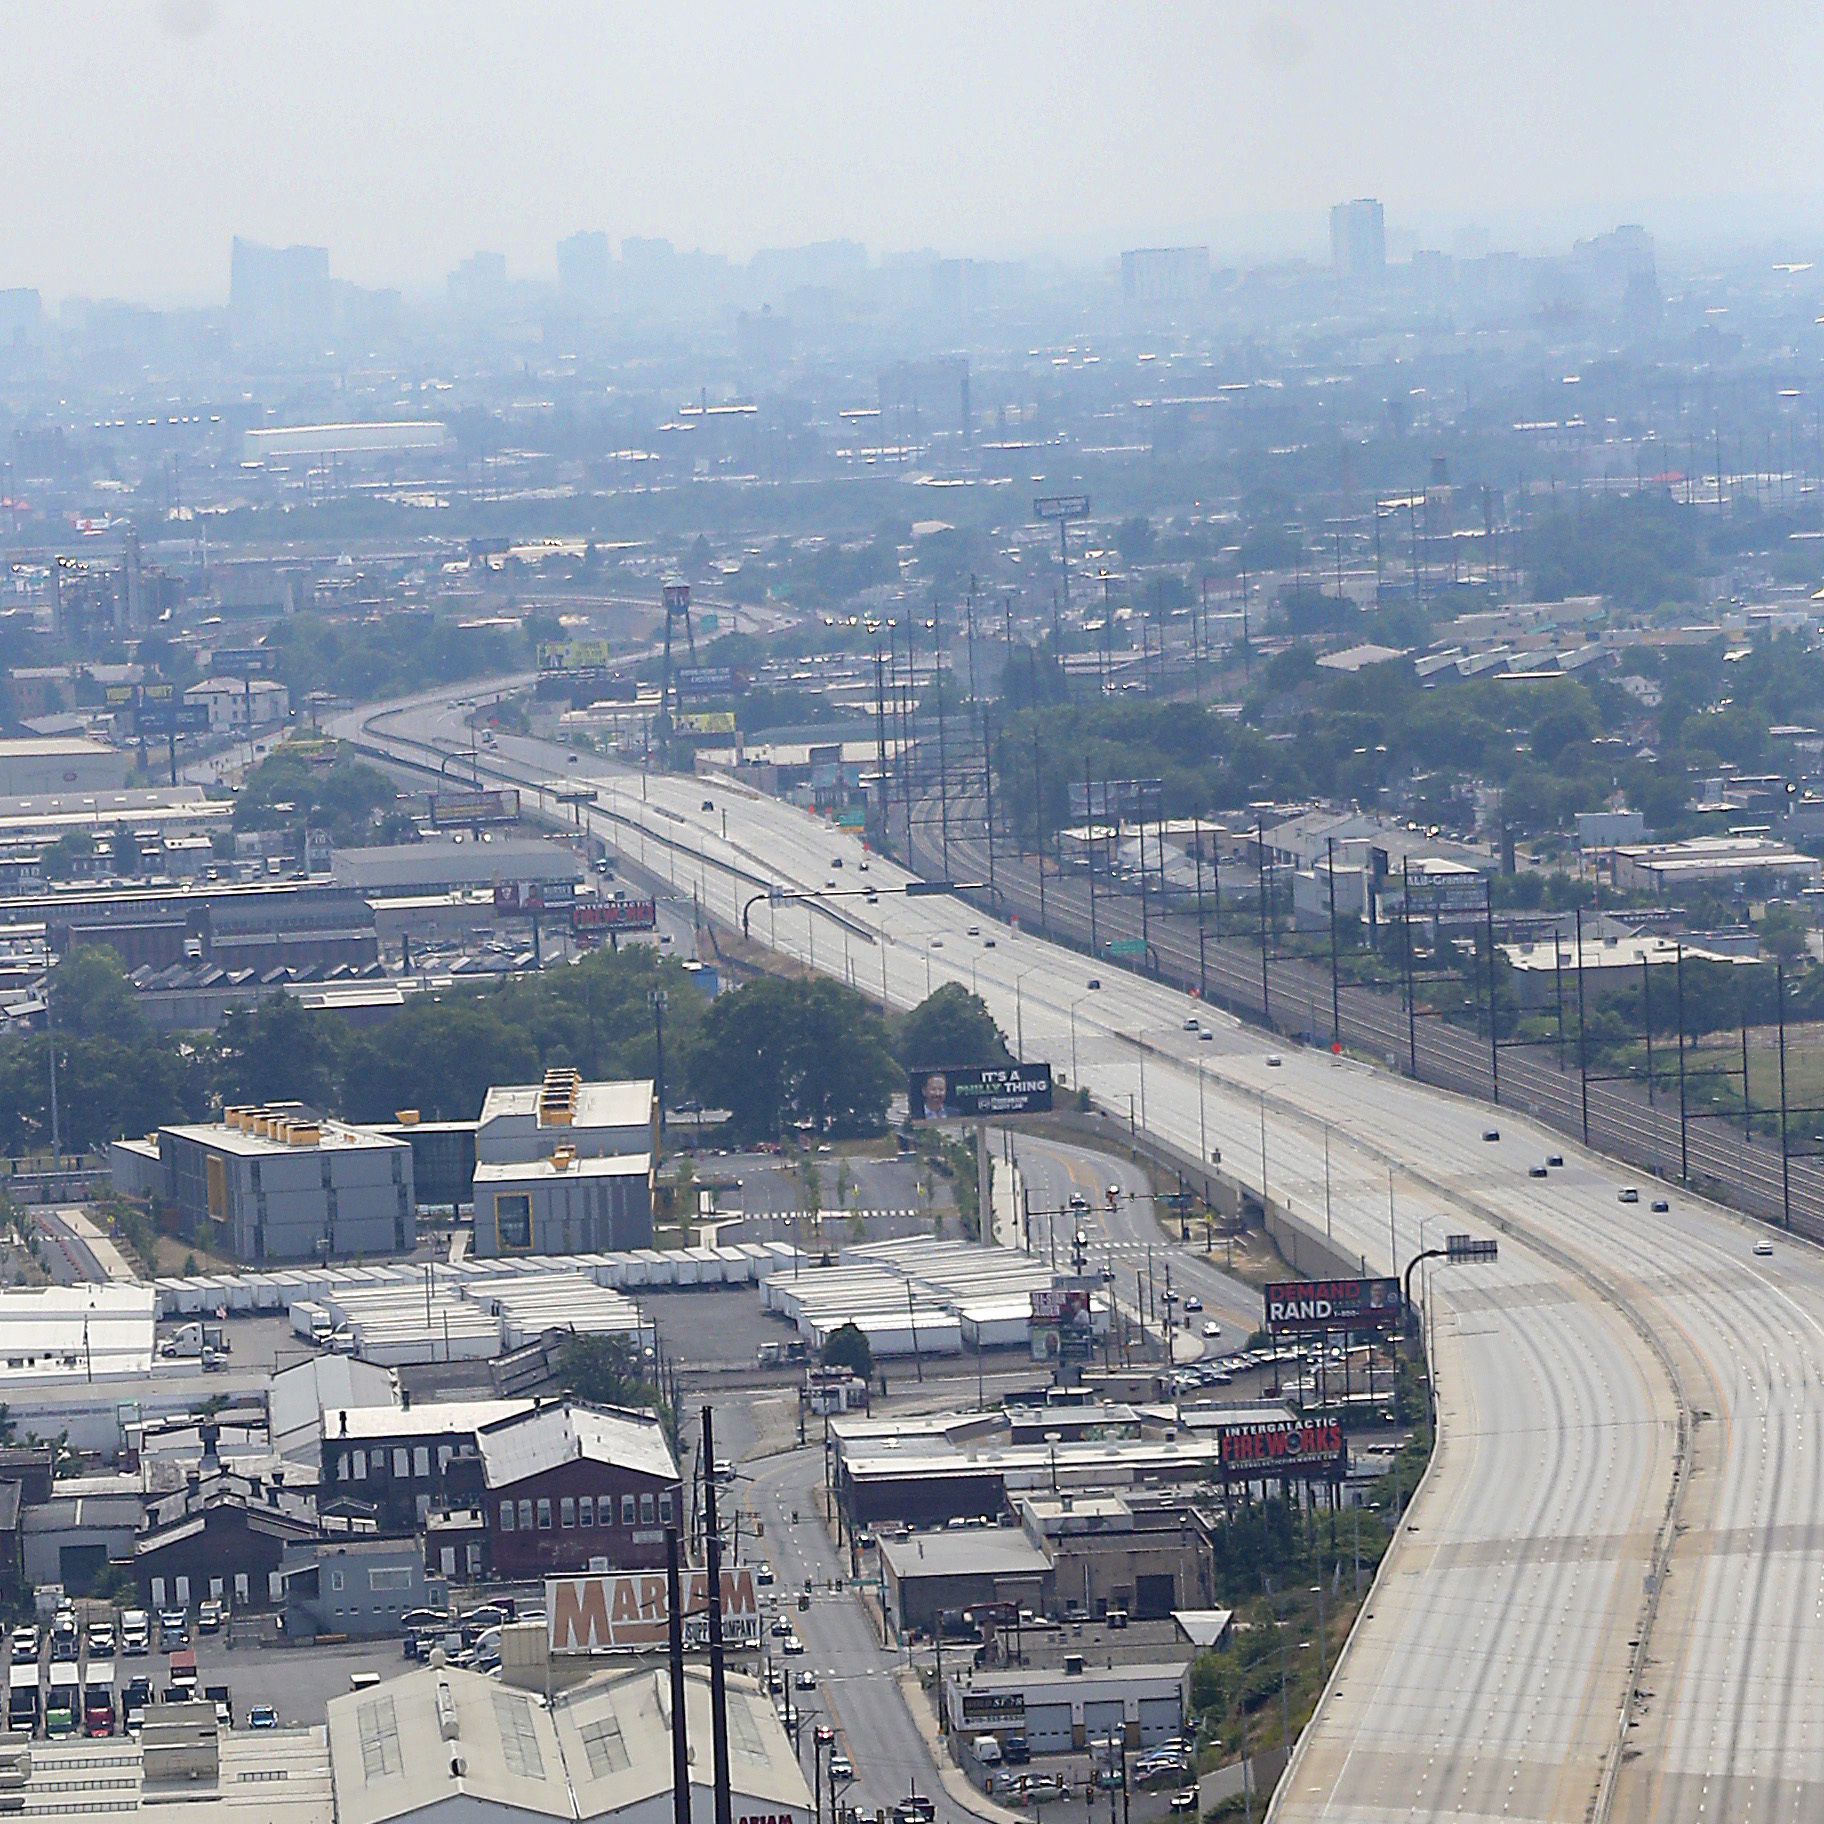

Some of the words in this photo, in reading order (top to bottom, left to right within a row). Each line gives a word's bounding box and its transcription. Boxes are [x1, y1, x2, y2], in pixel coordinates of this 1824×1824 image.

[982, 1072, 1006, 1082] IT'S
[1010, 1071, 1020, 1081] A
[1004, 1081, 1047, 1092] THING
[1270, 1282, 1360, 1300] DEMAND
[1270, 1300, 1332, 1320] RAND
[1225, 1418, 1337, 1437] INTERGALACTIC
[1222, 1425, 1341, 1460] FIREWORKS
